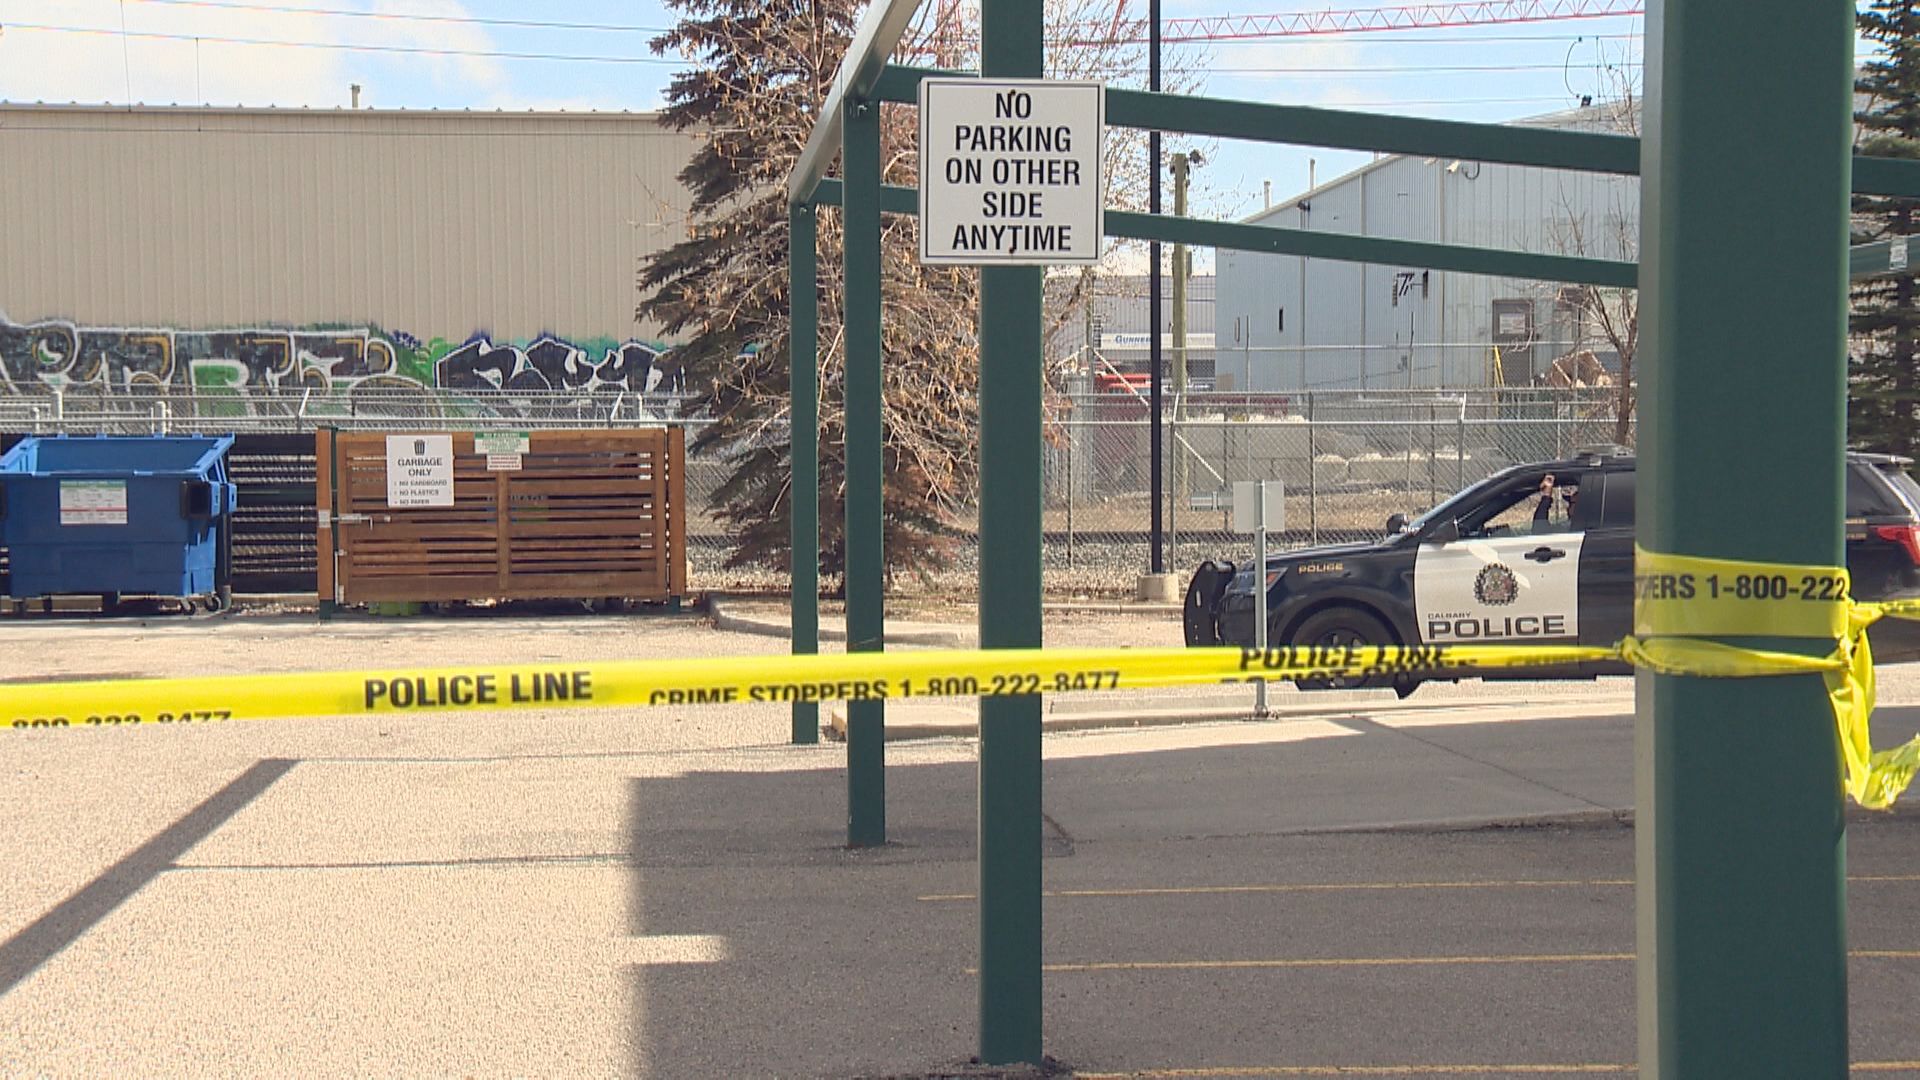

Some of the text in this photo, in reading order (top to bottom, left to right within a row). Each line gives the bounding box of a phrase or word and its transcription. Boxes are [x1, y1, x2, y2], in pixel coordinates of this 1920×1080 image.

[995, 92, 1032, 119] NO
[955, 125, 1071, 152] PARKING
[945, 157, 1080, 185] ON OTHER
[982, 191, 1043, 218] SIDE
[952, 224, 1071, 251] ANYTIME
[397, 458, 442, 467] GARBAGE
[408, 468, 432, 476] ONLY
[1298, 563, 1344, 574] POLICE
[1428, 615, 1566, 640] POLICE
[1239, 646, 1364, 670] POLICE
[364, 671, 593, 710] POLICE LINE
[650, 670, 1120, 705] CRIME STOPPERS 1-800-222-8477
